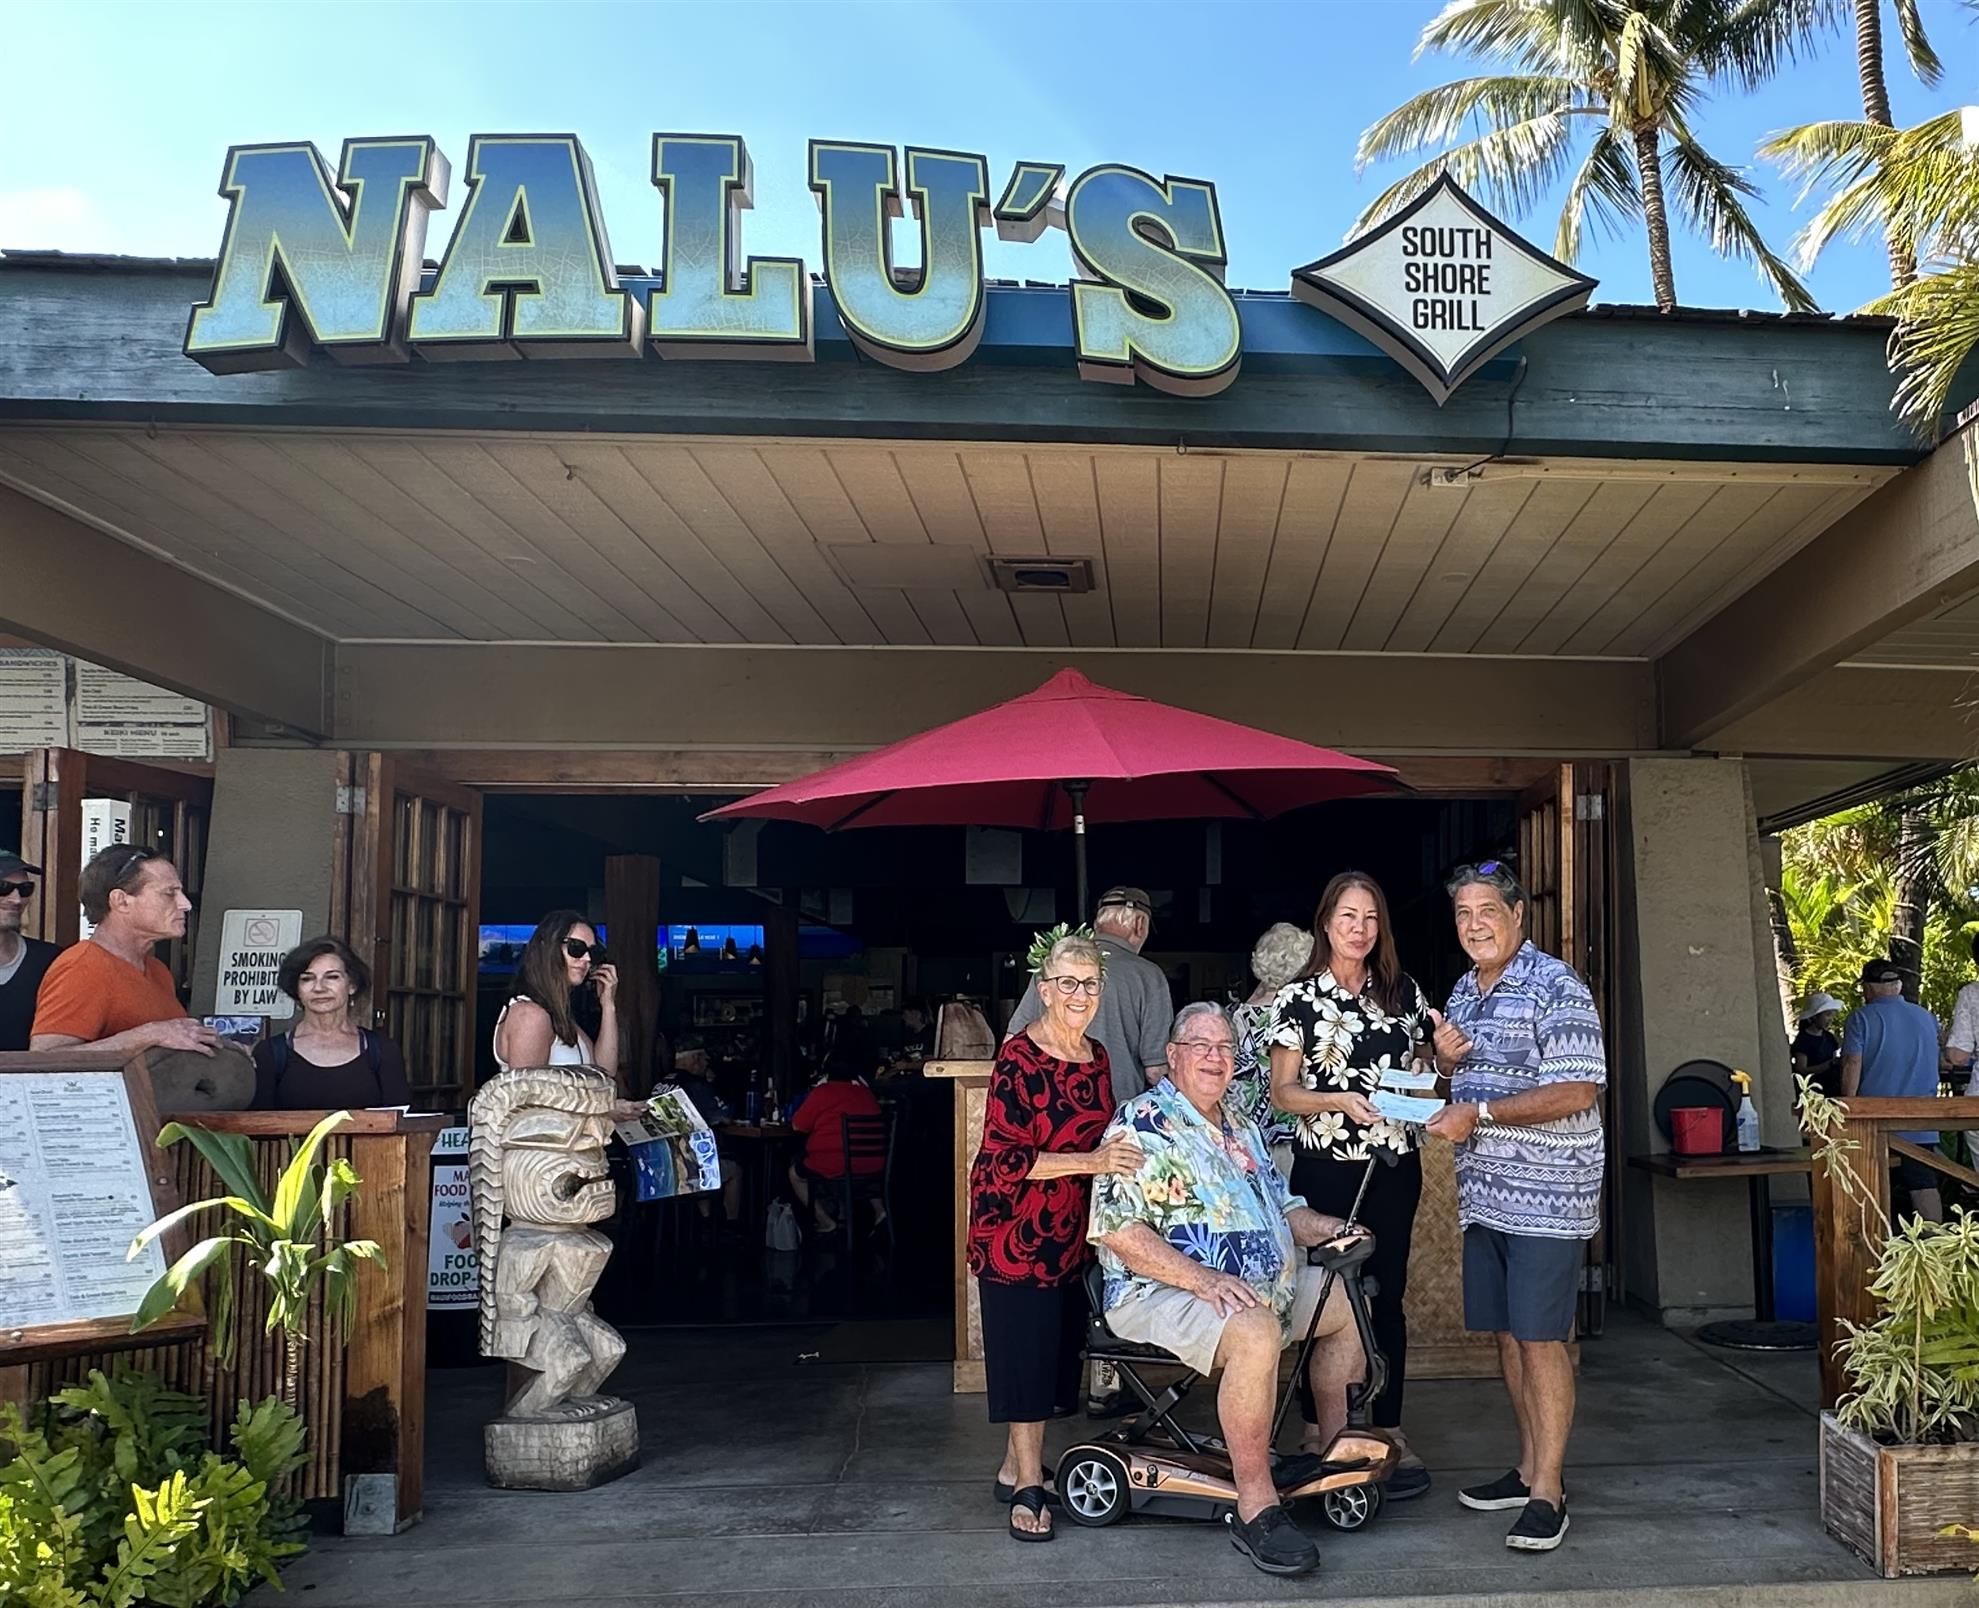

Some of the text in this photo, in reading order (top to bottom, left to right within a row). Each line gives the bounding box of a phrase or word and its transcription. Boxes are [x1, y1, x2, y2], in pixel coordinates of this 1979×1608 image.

[1402, 226, 1492, 259] SOUTH
[184, 132, 1243, 378] NALU'S
[1405, 262, 1492, 295] SHORE
[1413, 298, 1486, 332] GRILL
[90, 817, 101, 833] Ho
[114, 818, 126, 845] Ma
[223, 970, 280, 986] PROHIBIT
[234, 989, 278, 1005] BY LAW
[441, 1132, 469, 1148] HEA
[453, 1170, 470, 1183] MA
[434, 1184, 467, 1197] FOOD
[444, 1254, 478, 1270] FOO
[430, 1271, 476, 1287] DROP-
